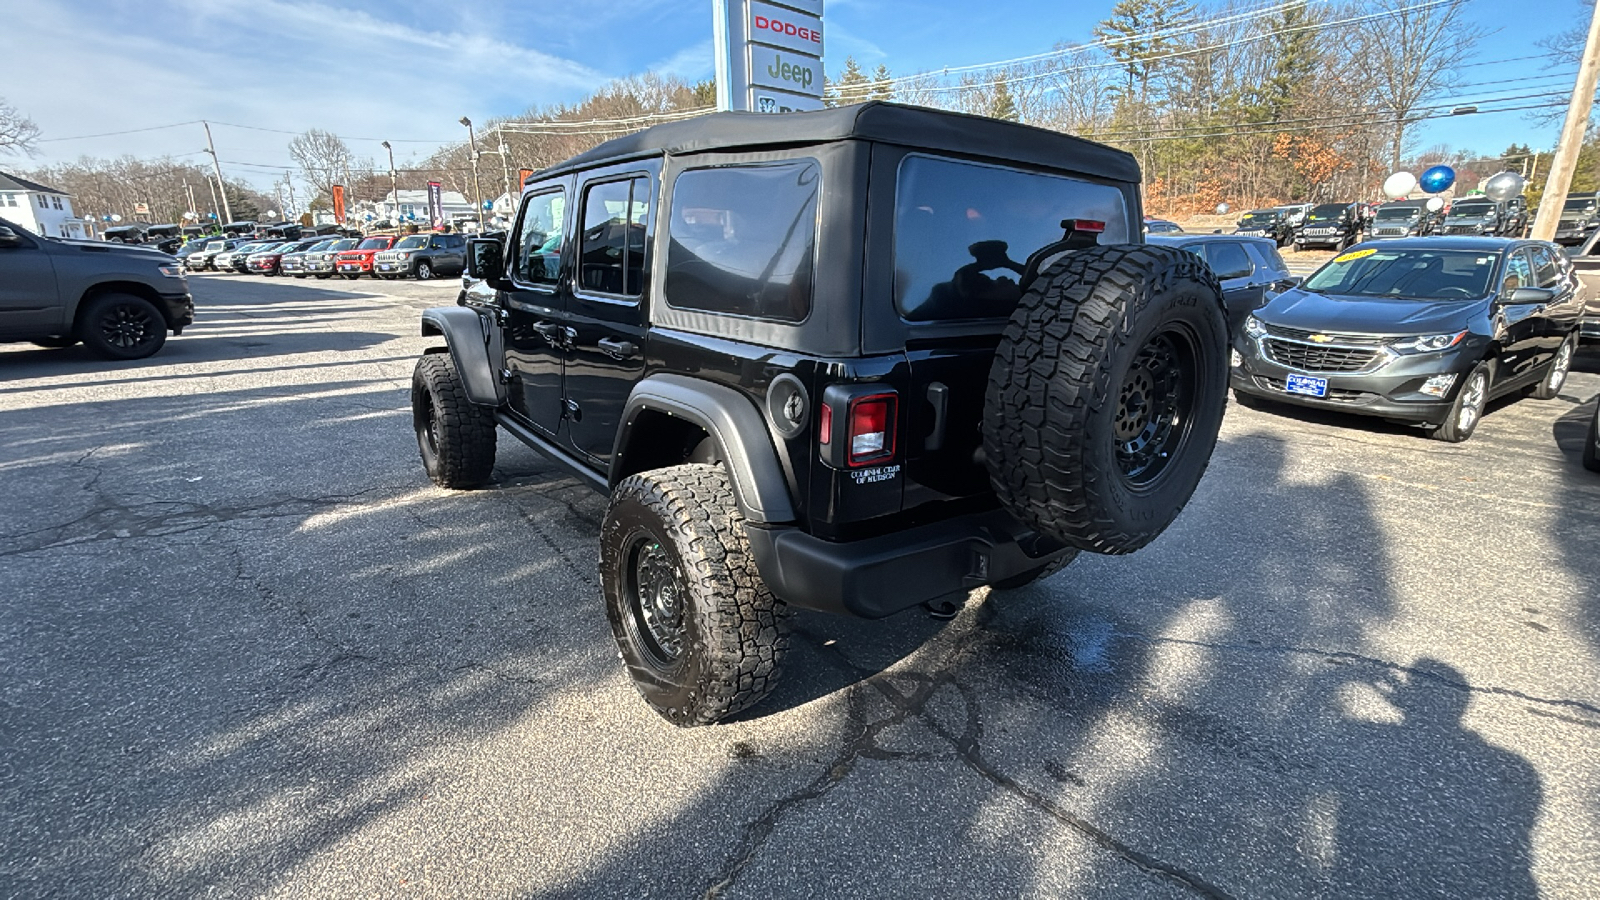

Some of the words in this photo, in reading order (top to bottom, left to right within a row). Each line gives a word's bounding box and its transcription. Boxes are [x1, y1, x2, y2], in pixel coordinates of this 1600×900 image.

[755, 15, 821, 43] DODGE
[768, 54, 813, 89] Jeep
[1288, 376, 1325, 387] COLONIAL
[851, 468, 883, 478] COLONIAL
[867, 473, 895, 482] HUDSON
